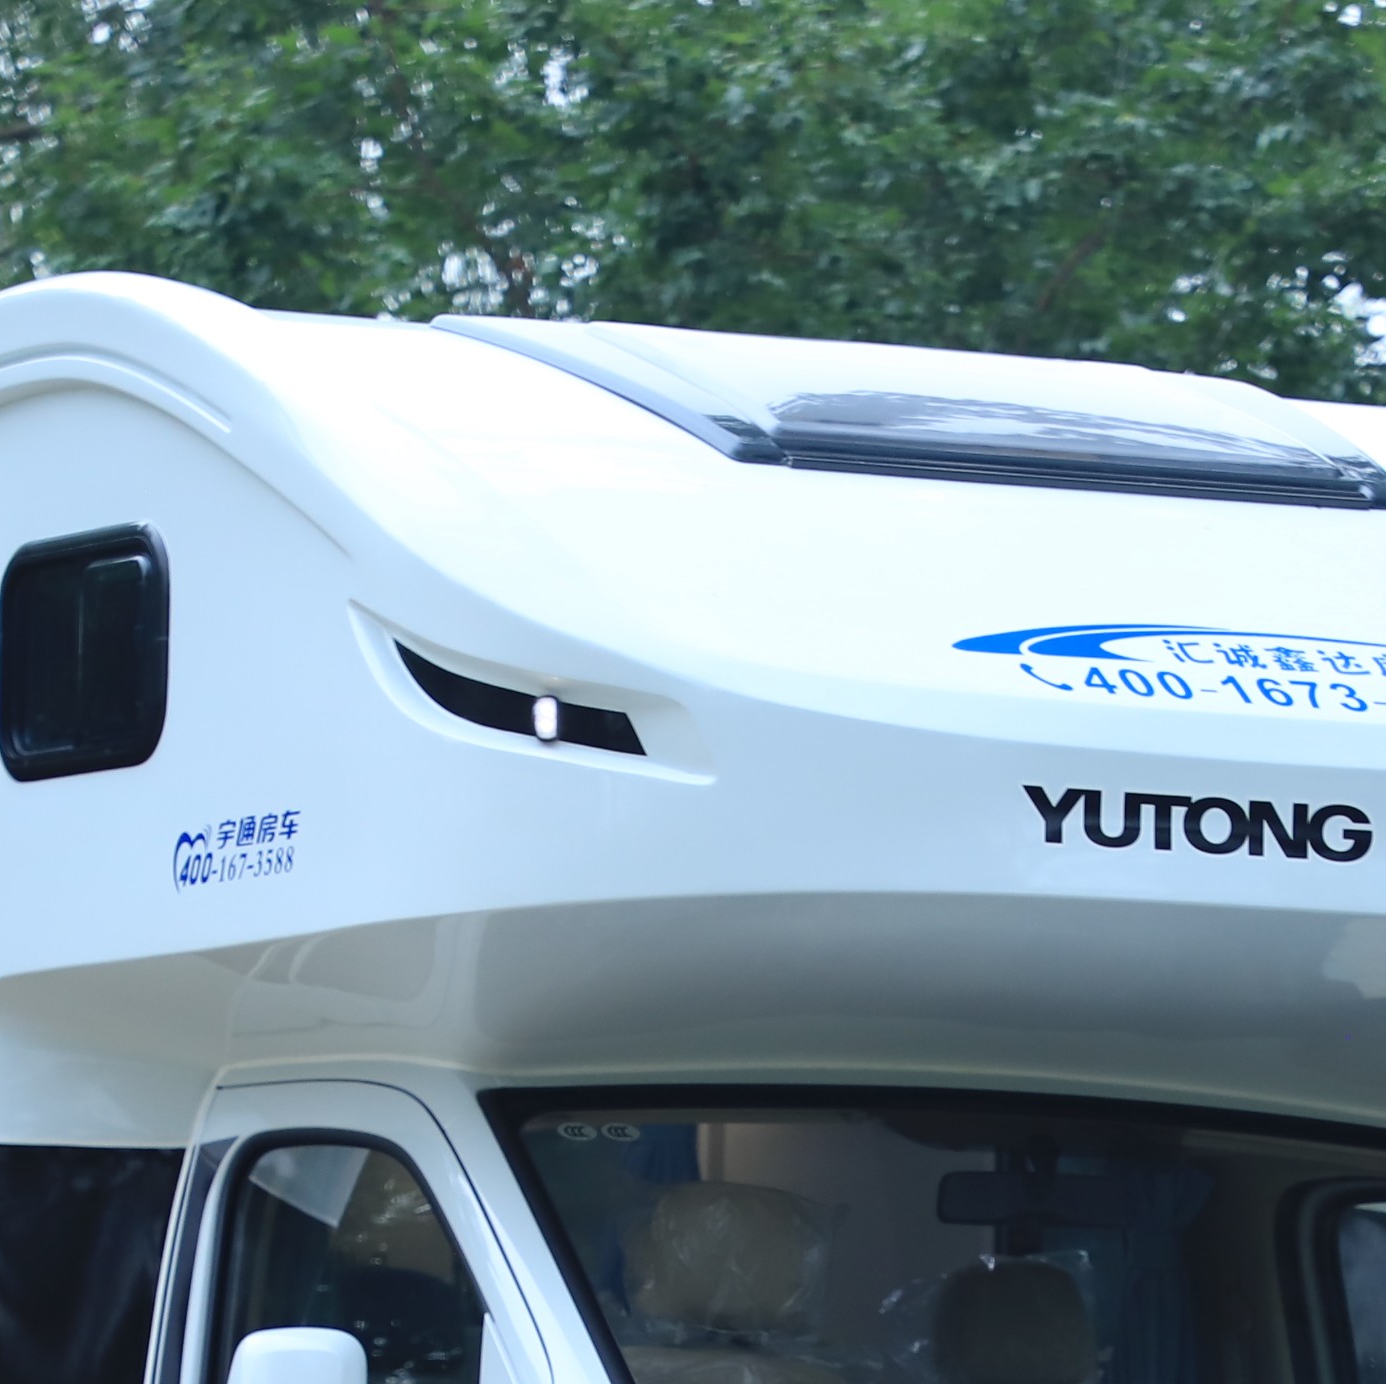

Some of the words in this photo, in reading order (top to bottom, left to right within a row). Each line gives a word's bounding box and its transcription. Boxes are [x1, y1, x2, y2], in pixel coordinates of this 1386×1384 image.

[216, 809, 301, 850] 宇通房车
[1022, 784, 1373, 864] YUTONG
[179, 845, 296, 888] 400-167-3588
